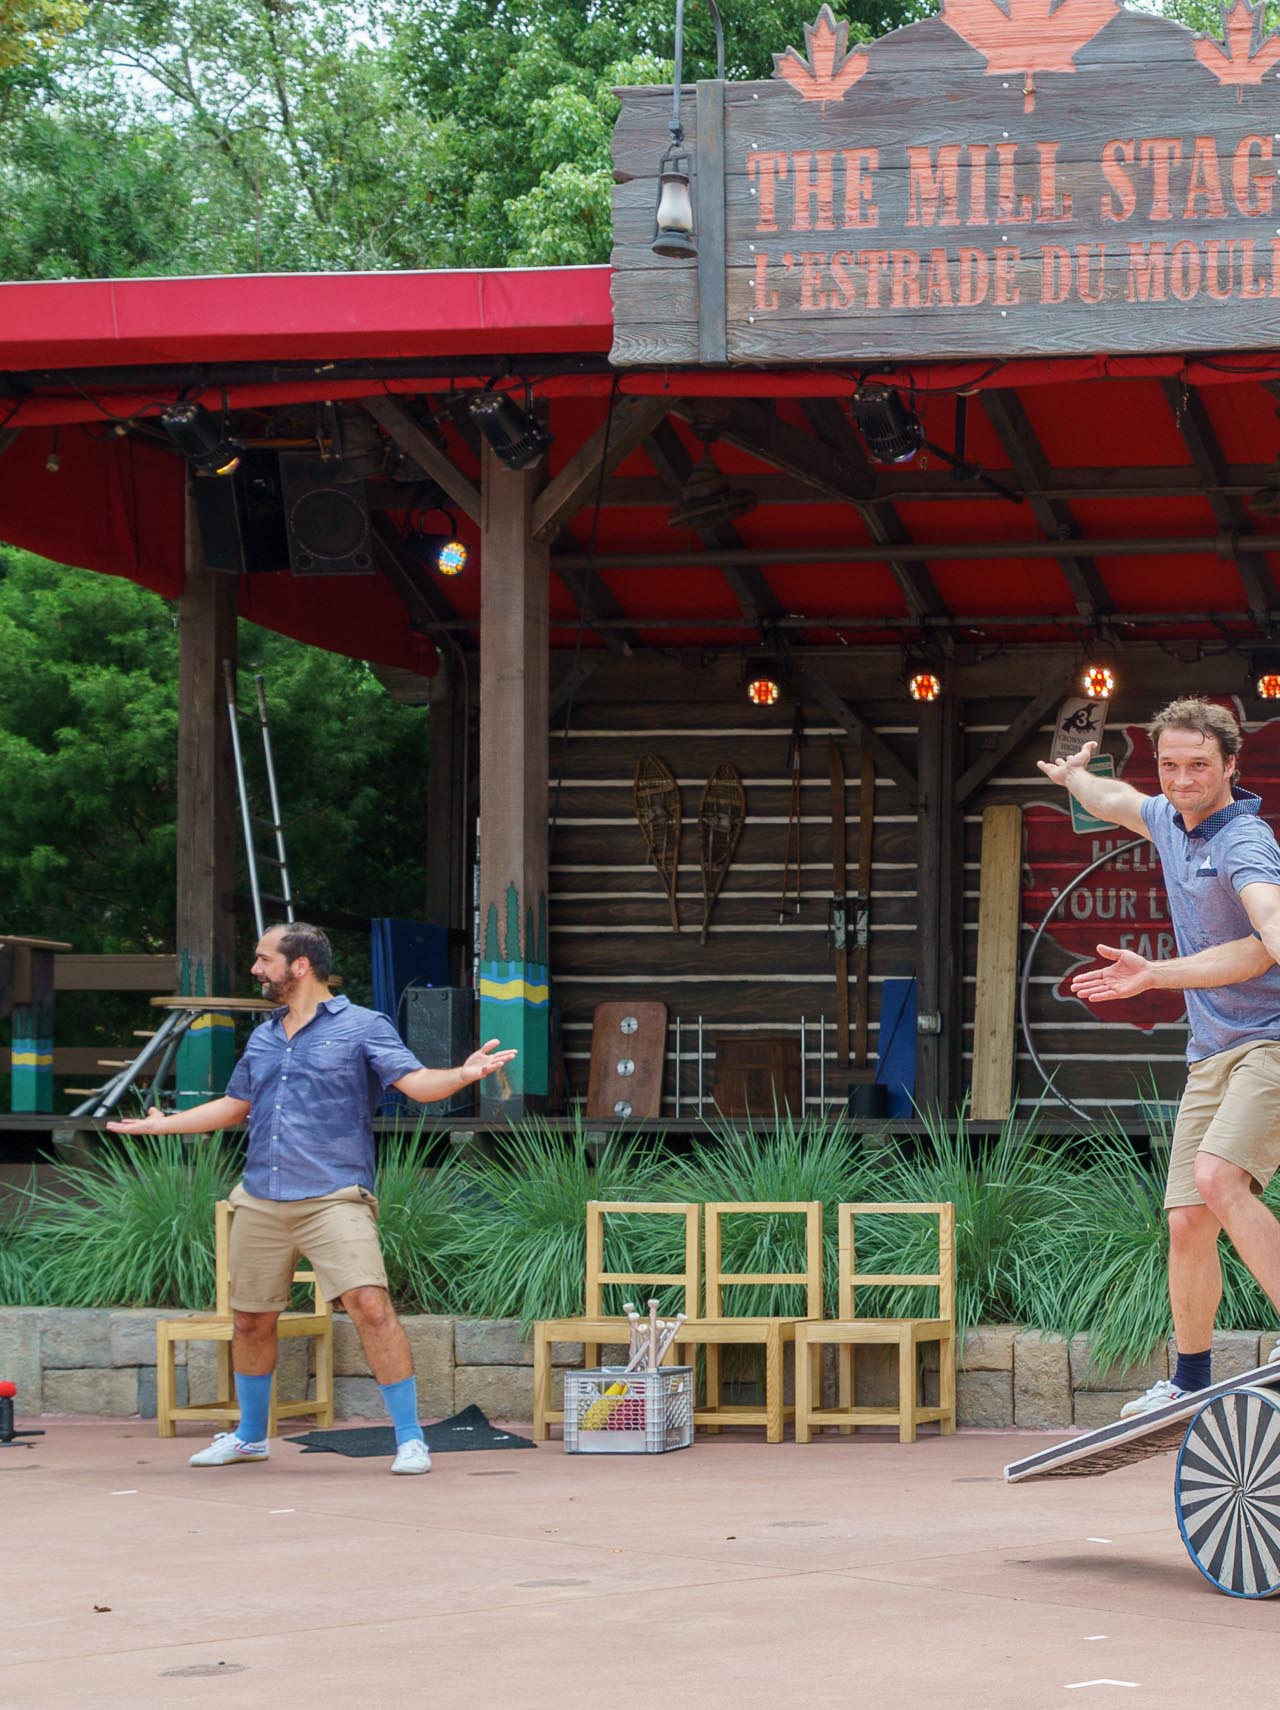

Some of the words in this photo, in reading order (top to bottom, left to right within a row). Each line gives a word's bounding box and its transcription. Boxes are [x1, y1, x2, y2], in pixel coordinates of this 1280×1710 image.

[747, 147, 879, 231] THE
[904, 141, 1073, 226] MILL
[753, 245, 1020, 310] L'ESTRADE
[1040, 242, 1106, 304] DU
[1076, 710, 1089, 727] 3
[1051, 887, 1138, 920] YOUR
